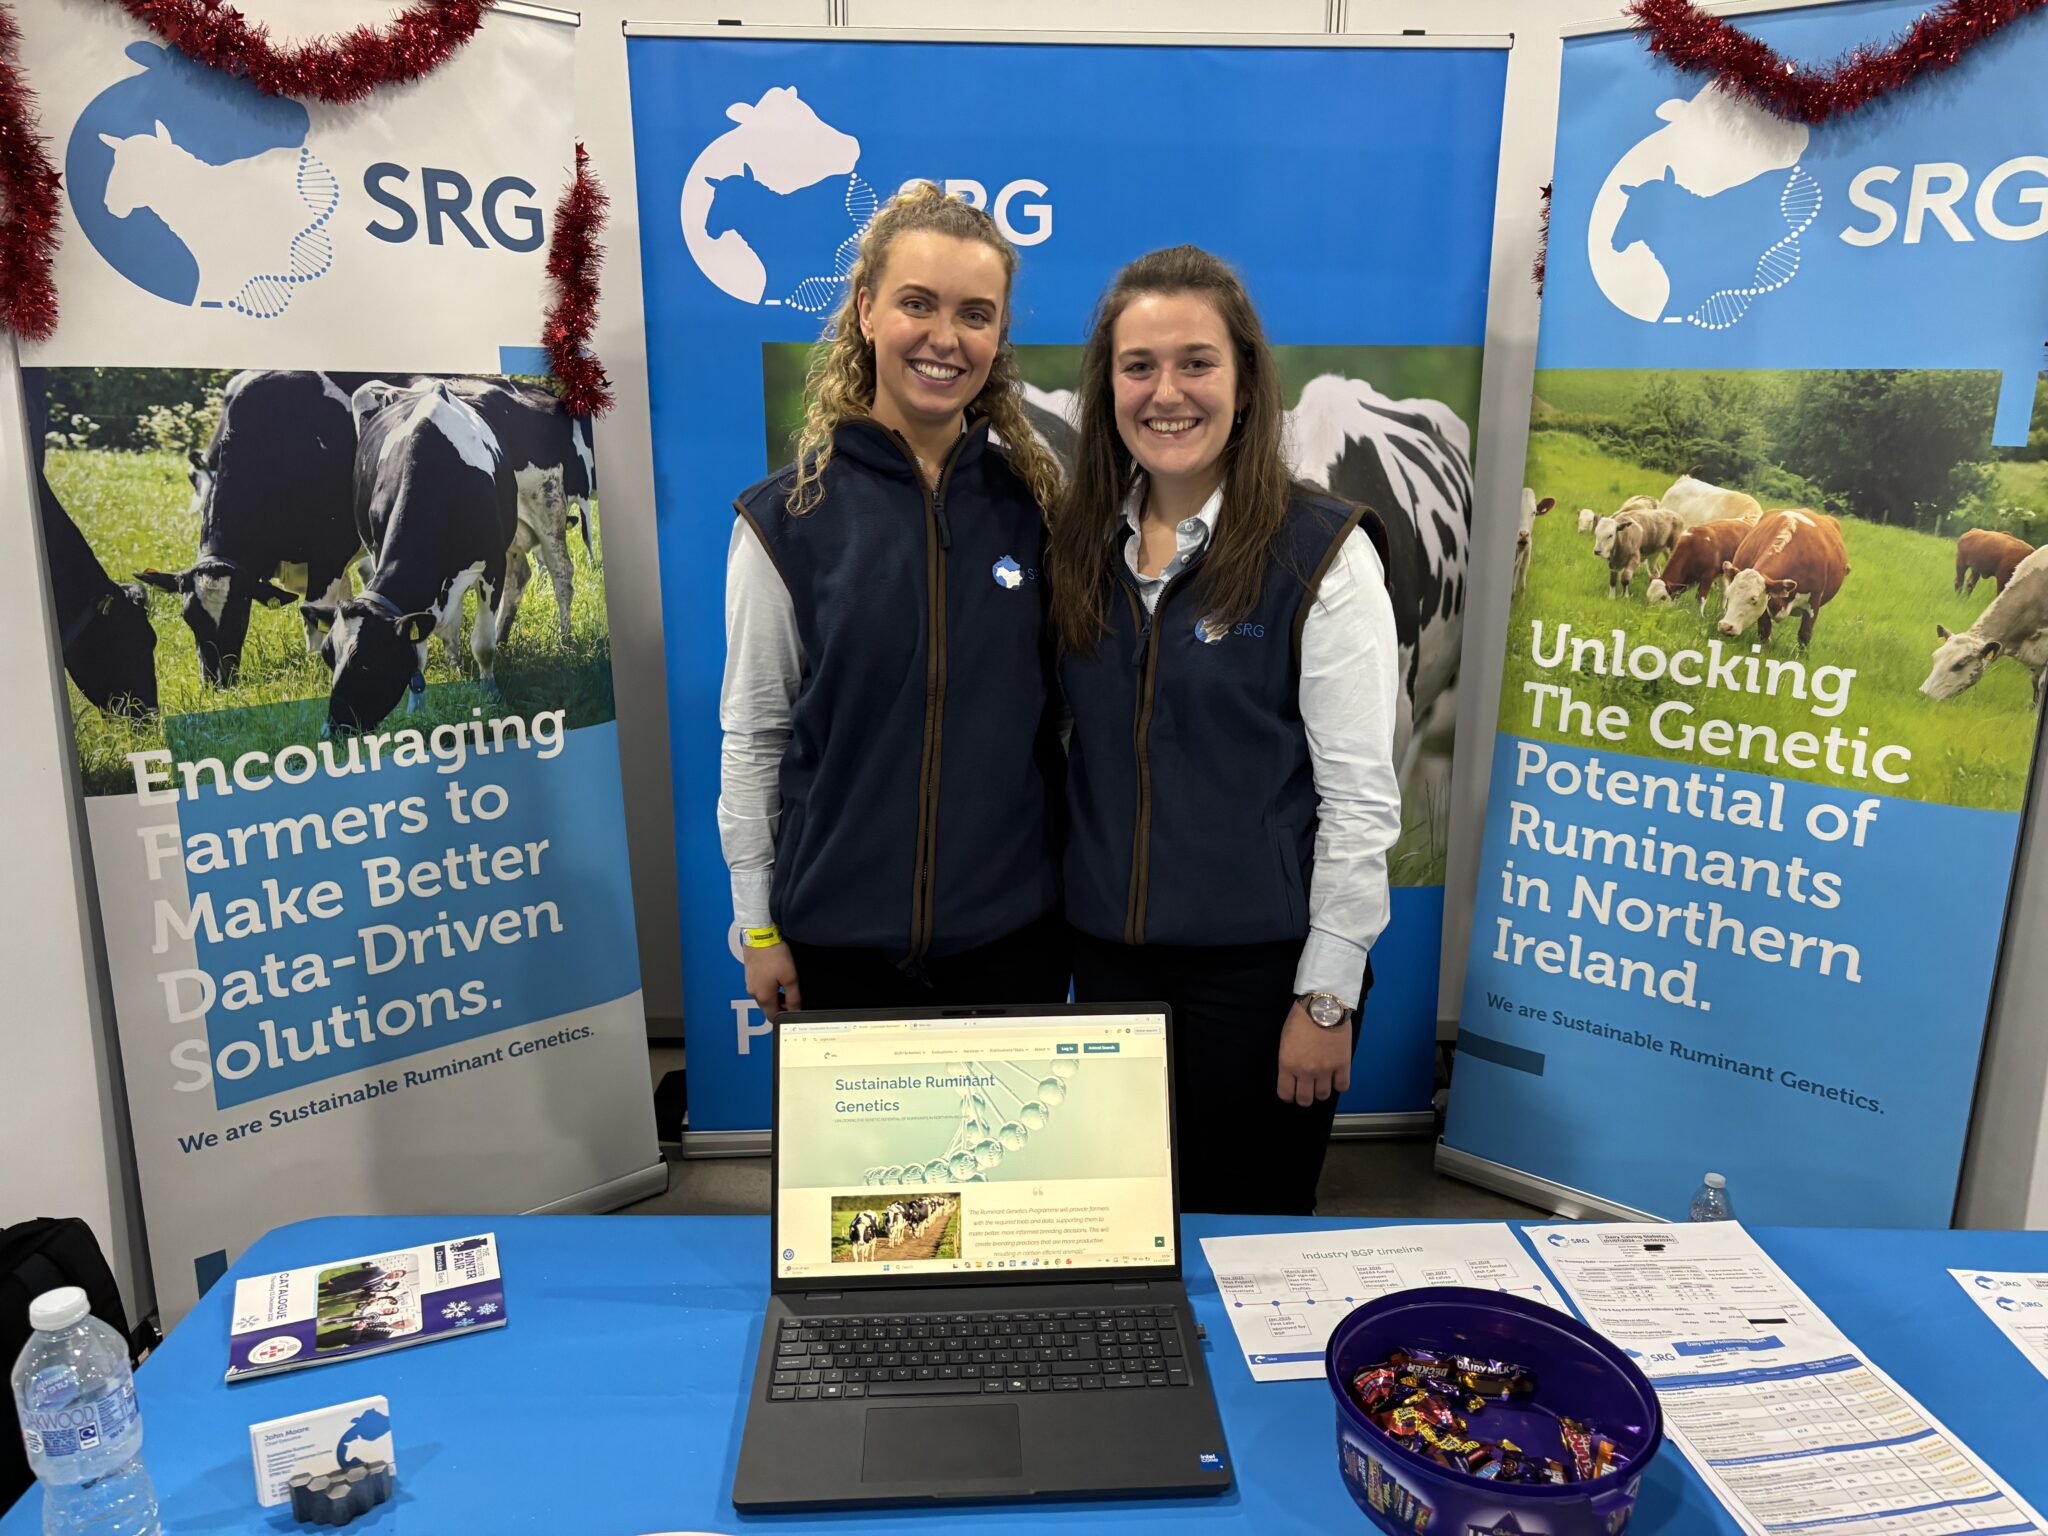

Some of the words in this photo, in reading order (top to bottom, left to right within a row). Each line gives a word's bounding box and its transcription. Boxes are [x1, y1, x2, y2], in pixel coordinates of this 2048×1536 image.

[363, 161, 546, 253] SRG
[1838, 155, 2048, 247] SRG
[1233, 622, 1265, 639] SRG
[1530, 619, 1857, 718] Unlocking
[127, 708, 567, 807] Encouraging
[1522, 680, 1631, 741] The
[1649, 700, 1912, 786] Genetic
[137, 797, 429, 882] Farmers
[446, 779, 509, 824] to
[1514, 740, 1785, 832] Potential
[1805, 796, 1881, 848] of
[151, 877, 345, 954] Make
[362, 839, 550, 908] Better
[1508, 800, 1843, 910] Ruminants
[157, 900, 563, 1024] Data-Driven
[1491, 916, 1712, 1013] Ireland.
[1500, 861, 1551, 913] in
[1567, 875, 1863, 985] Northern
[169, 977, 503, 1094] Solutions.
[1486, 991, 1514, 1014] We
[1518, 1001, 1548, 1023] are
[1552, 1008, 1664, 1054] Sustainable
[1669, 1039, 1775, 1085] Ruminant
[1780, 1068, 1886, 1116] Genetics.
[178, 1128, 219, 1155] We
[225, 1116, 264, 1140] are
[268, 1075, 399, 1128] Sustainable
[404, 1046, 503, 1089] Ruminant
[508, 1024, 596, 1059] Genetics.
[835, 1076, 922, 1091] Sustainable
[925, 1074, 996, 1088] Ruminant
[835, 1099, 900, 1113] Genetics
[435, 1250, 444, 1271] Danske
[452, 1251, 466, 1272] FAIR
[464, 1250, 478, 1281] WINTER
[1302, 1250, 1349, 1260] Industry
[1351, 1248, 1374, 1258] BGP
[1376, 1245, 1424, 1257] timeline
[1570, 1237, 1590, 1245] SRG
[276, 1272, 290, 1320] CATALOGUE
[1456, 1360, 1488, 1374] DAIRY
[1487, 1365, 1511, 1376] MILK
[1650, 1352, 1676, 1363] SRG
[264, 1432, 285, 1442] John
[285, 1426, 311, 1437] Moore
